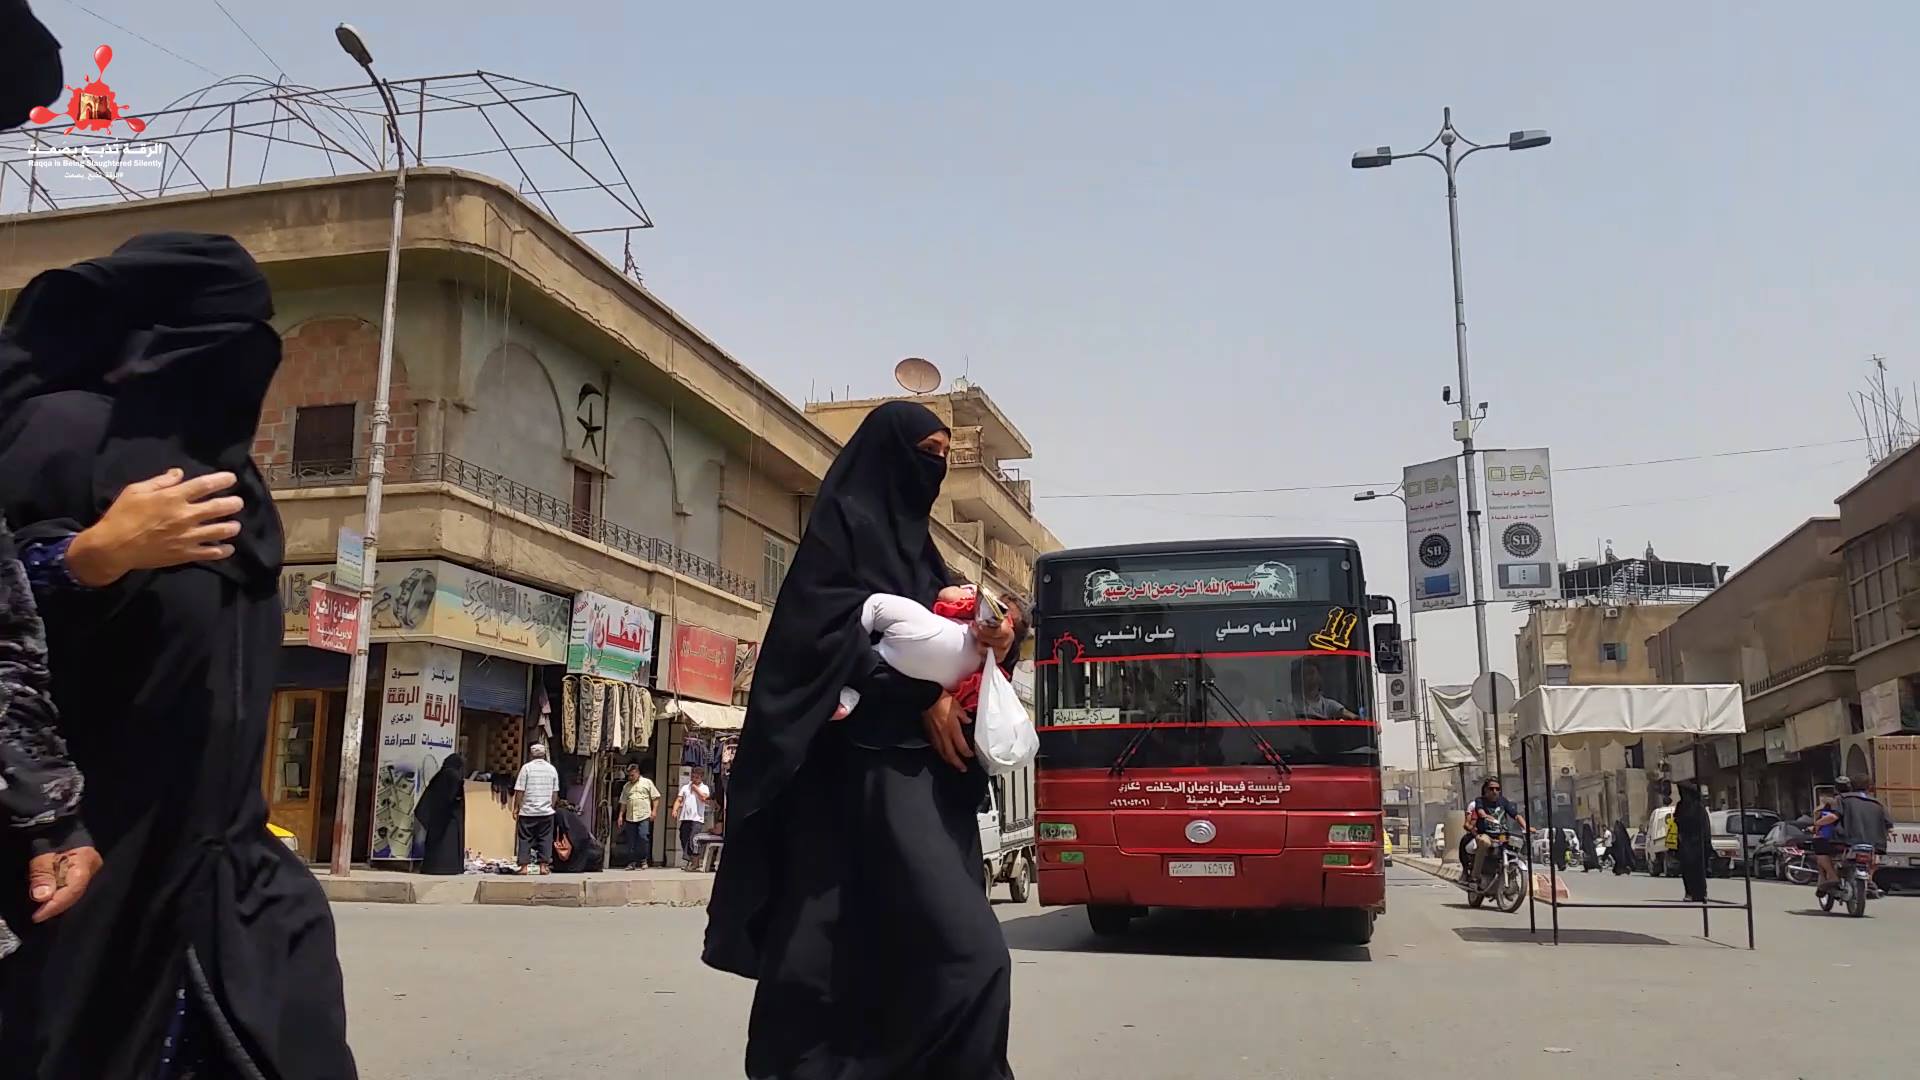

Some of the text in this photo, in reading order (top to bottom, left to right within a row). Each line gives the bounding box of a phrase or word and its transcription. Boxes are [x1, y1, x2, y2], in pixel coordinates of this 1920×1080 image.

[1103, 577, 1260, 600] بسم الله الرحمن الرحيم
[1095, 625, 1175, 648] على النبي
[1216, 618, 1297, 641] اللهم صلي
[391, 667, 419, 679] سوق
[387, 685, 420, 706] الرقة
[424, 692, 456, 727] الرقة
[384, 733, 416, 747] للصرافة
[1146, 781, 1186, 794] المخلف
[1215, 781, 1246, 794] فيصل
[1247, 781, 1291, 794] مؤسسة
[1185, 794, 1280, 808] نقل داخلي مدينة
